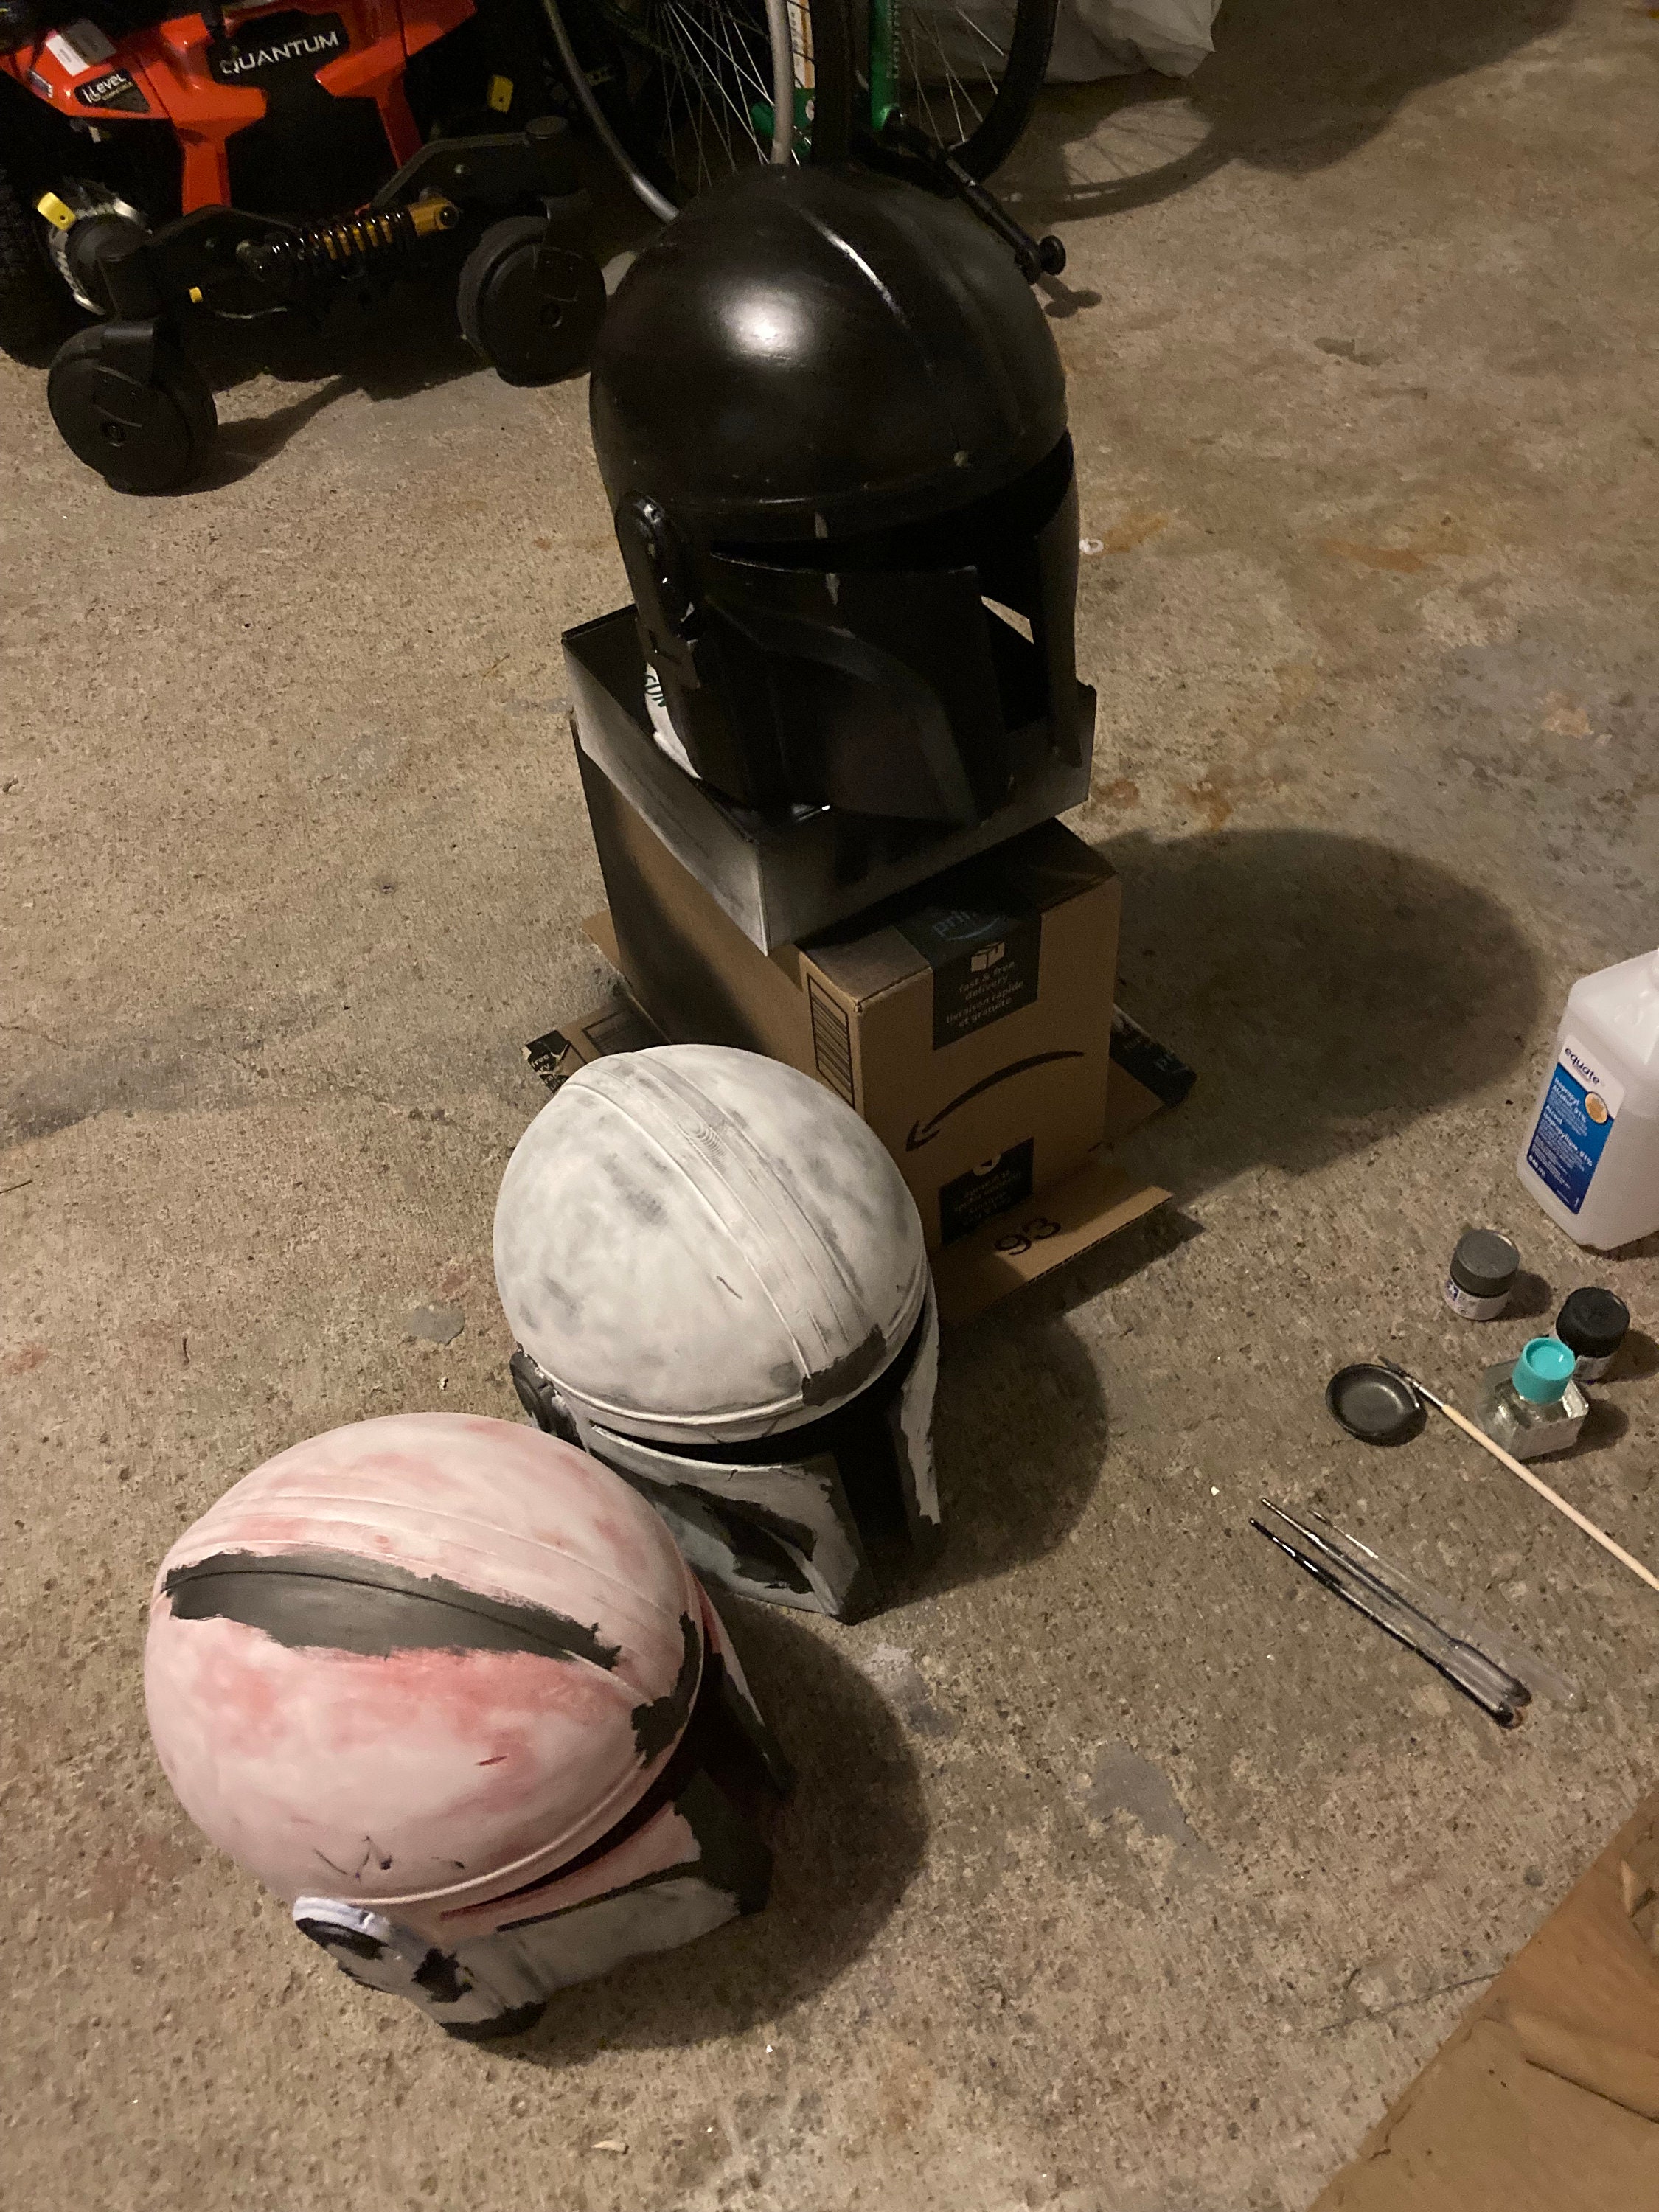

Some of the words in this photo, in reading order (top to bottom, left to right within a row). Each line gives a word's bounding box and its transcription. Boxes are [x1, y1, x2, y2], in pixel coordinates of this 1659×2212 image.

[220, 31, 338, 74] QUANTUM
[531, 1054, 549, 1068] free
[1565, 1048, 1600, 1085] equate
[993, 1217, 1062, 1256] 93
